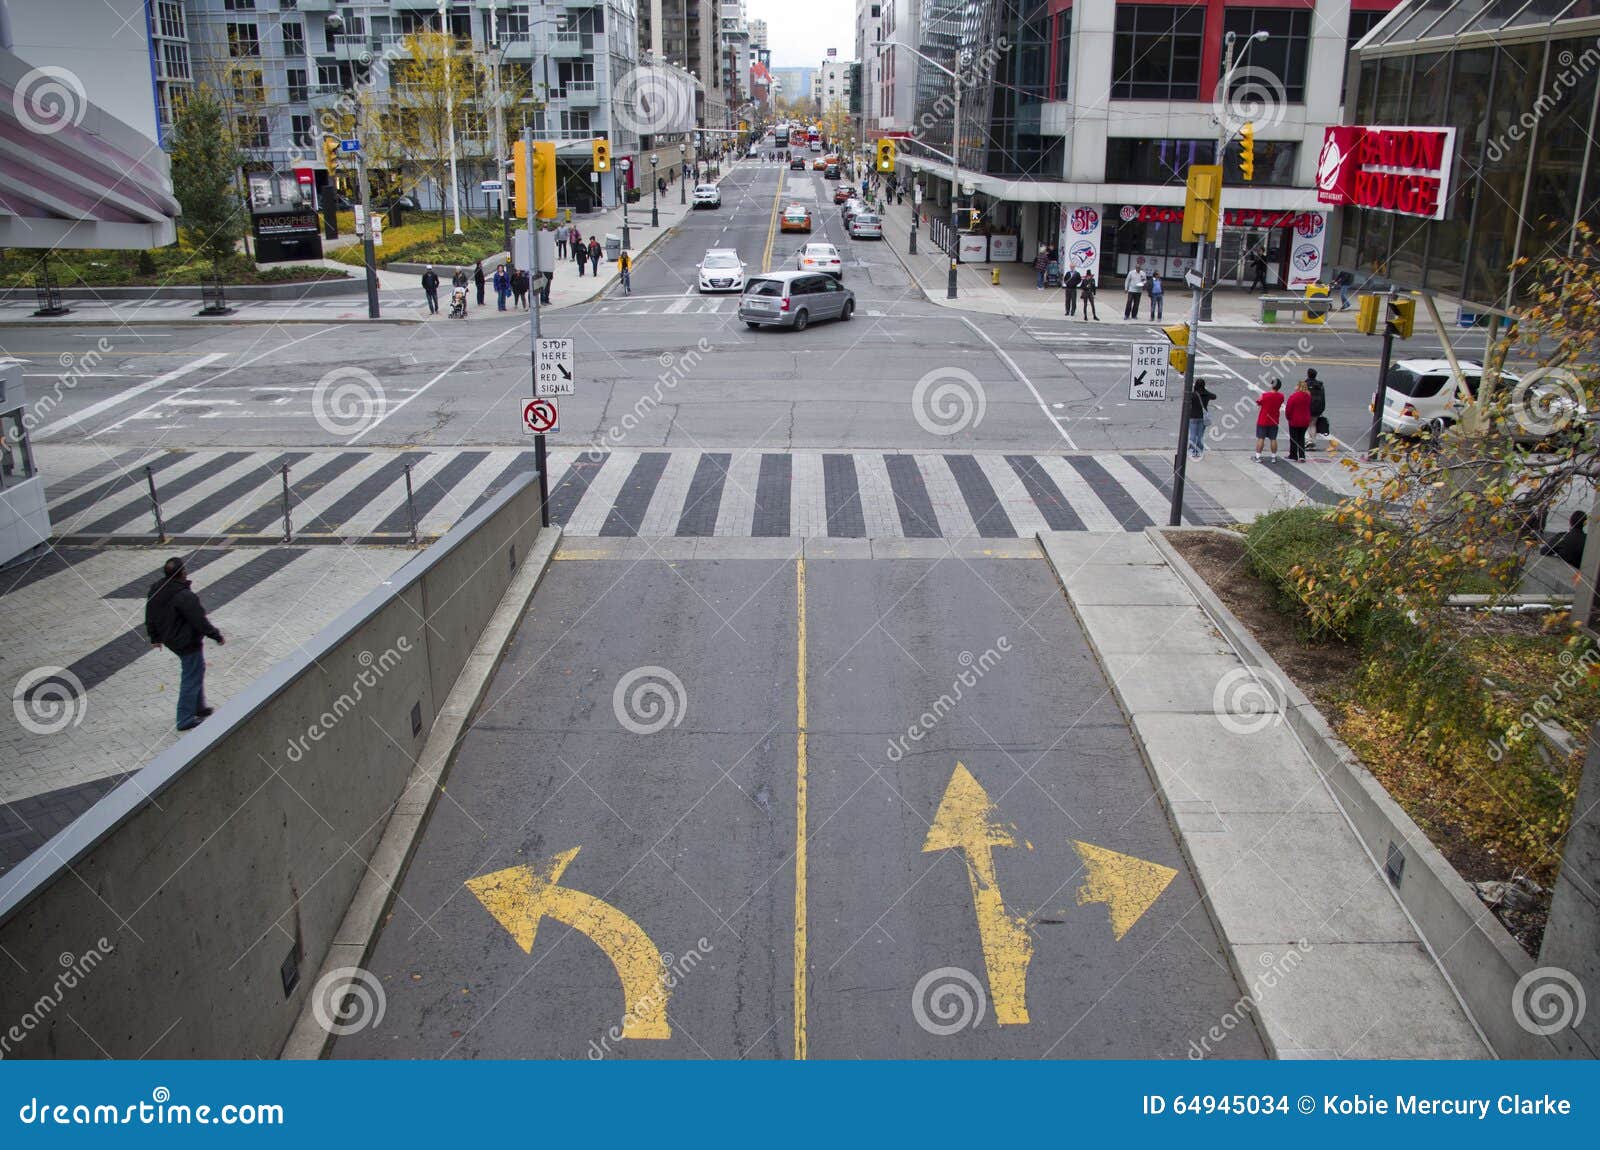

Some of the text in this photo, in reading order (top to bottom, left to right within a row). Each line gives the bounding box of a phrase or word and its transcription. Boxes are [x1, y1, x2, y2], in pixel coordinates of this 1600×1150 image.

[1353, 171, 1440, 215] ROUGE
[542, 341, 567, 349] STOP
[1139, 346, 1163, 355] STOP
[541, 352, 567, 360] HERE
[1137, 358, 1163, 366] HERE
[540, 363, 551, 371] ON
[1155, 369, 1165, 377] ON
[540, 374, 557, 382] RED
[541, 385, 570, 393] SIGNAL
[1136, 390, 1163, 398] SIGNAL
